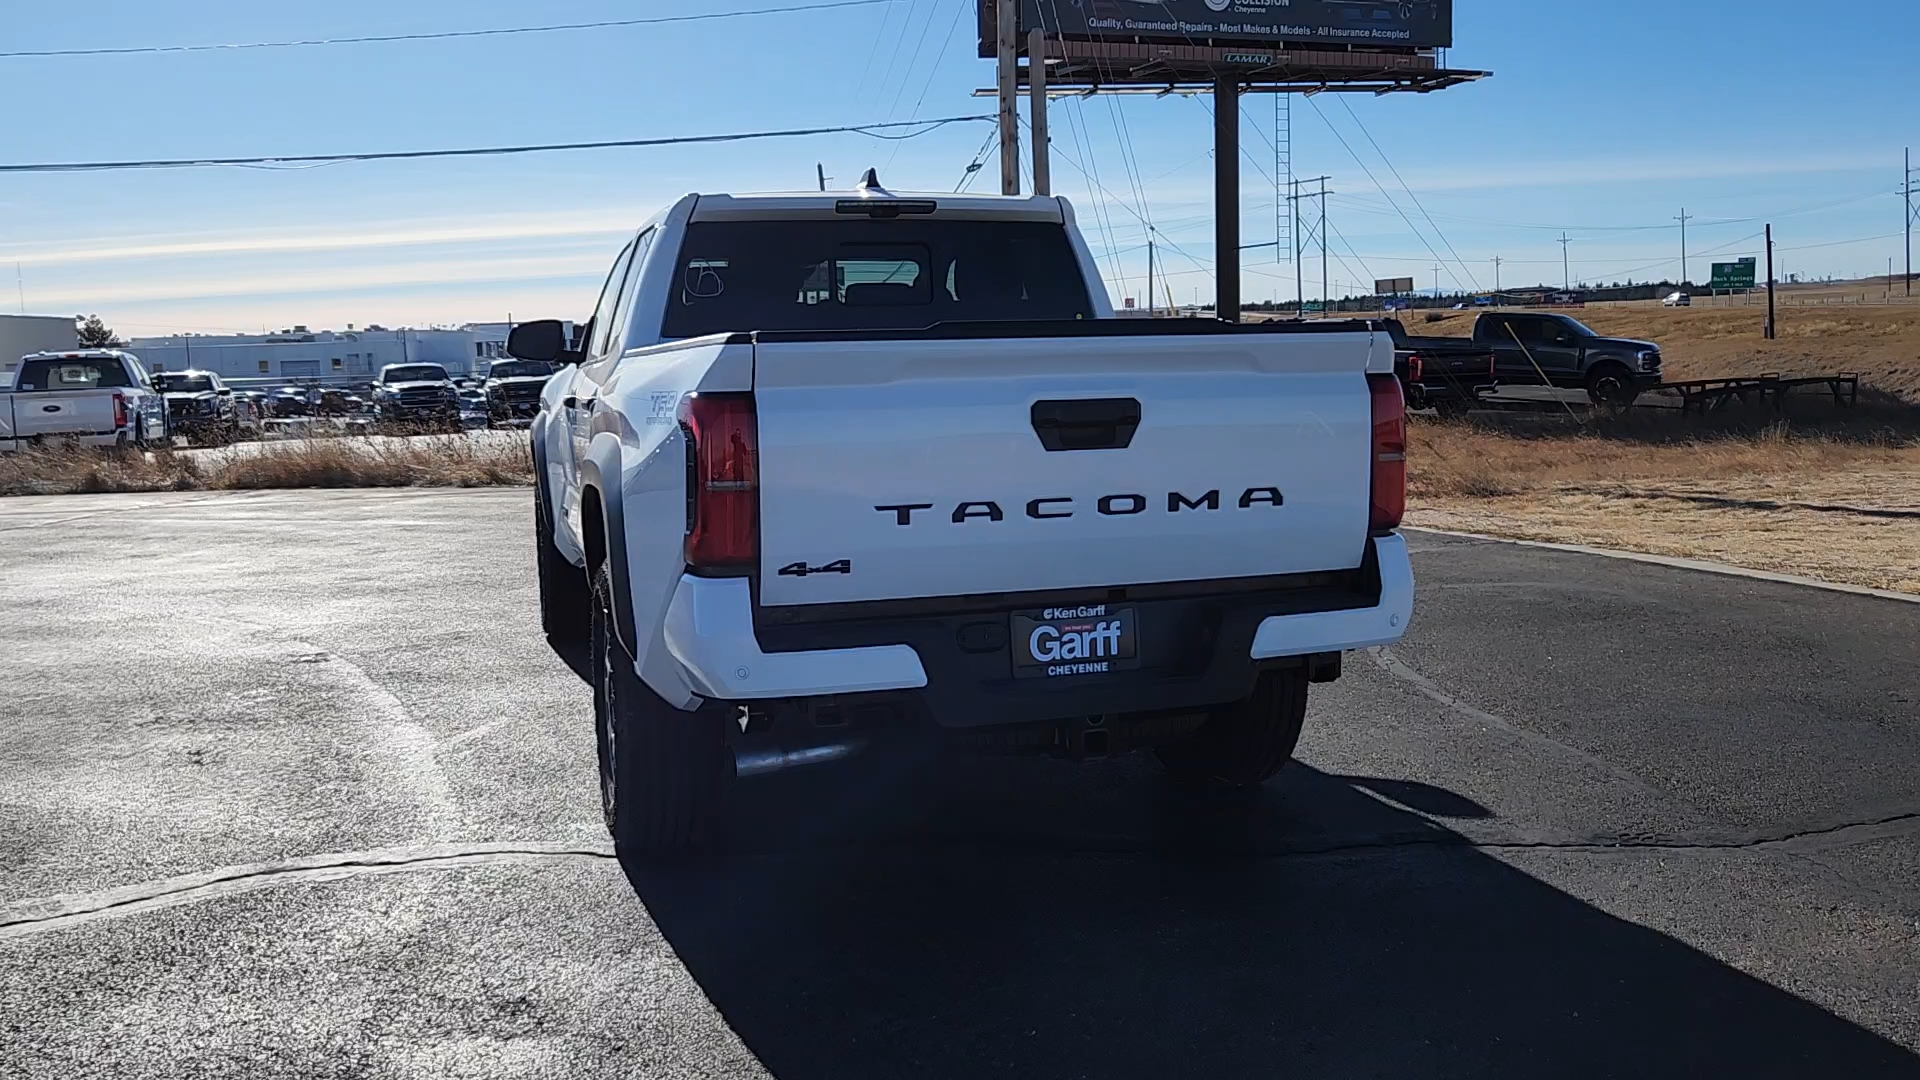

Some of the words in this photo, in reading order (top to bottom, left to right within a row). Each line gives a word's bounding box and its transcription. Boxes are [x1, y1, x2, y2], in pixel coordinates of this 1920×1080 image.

[1234, 5, 1266, 14] Cheyenne
[1088, 17, 1123, 30] Quality,
[1125, 19, 1177, 31] Guaranteed
[1179, 22, 1212, 33] Repairs
[1219, 25, 1241, 33] Most
[1243, 24, 1270, 34] Makes
[1272, 25, 1278, 34] &
[1280, 25, 1310, 35] Models
[1317, 27, 1328, 36] All
[1329, 27, 1370, 37] Insurance
[1371, 29, 1409, 39] Accepted
[1227, 55, 1268, 64] LAMAR
[874, 487, 1284, 526] TACOMA
[778, 559, 851, 576] 4x4
[1054, 608, 1076, 618] Ken
[1077, 605, 1105, 617] Garff
[1030, 620, 1121, 661] Garff
[1048, 662, 1108, 676] CHEYENNE
